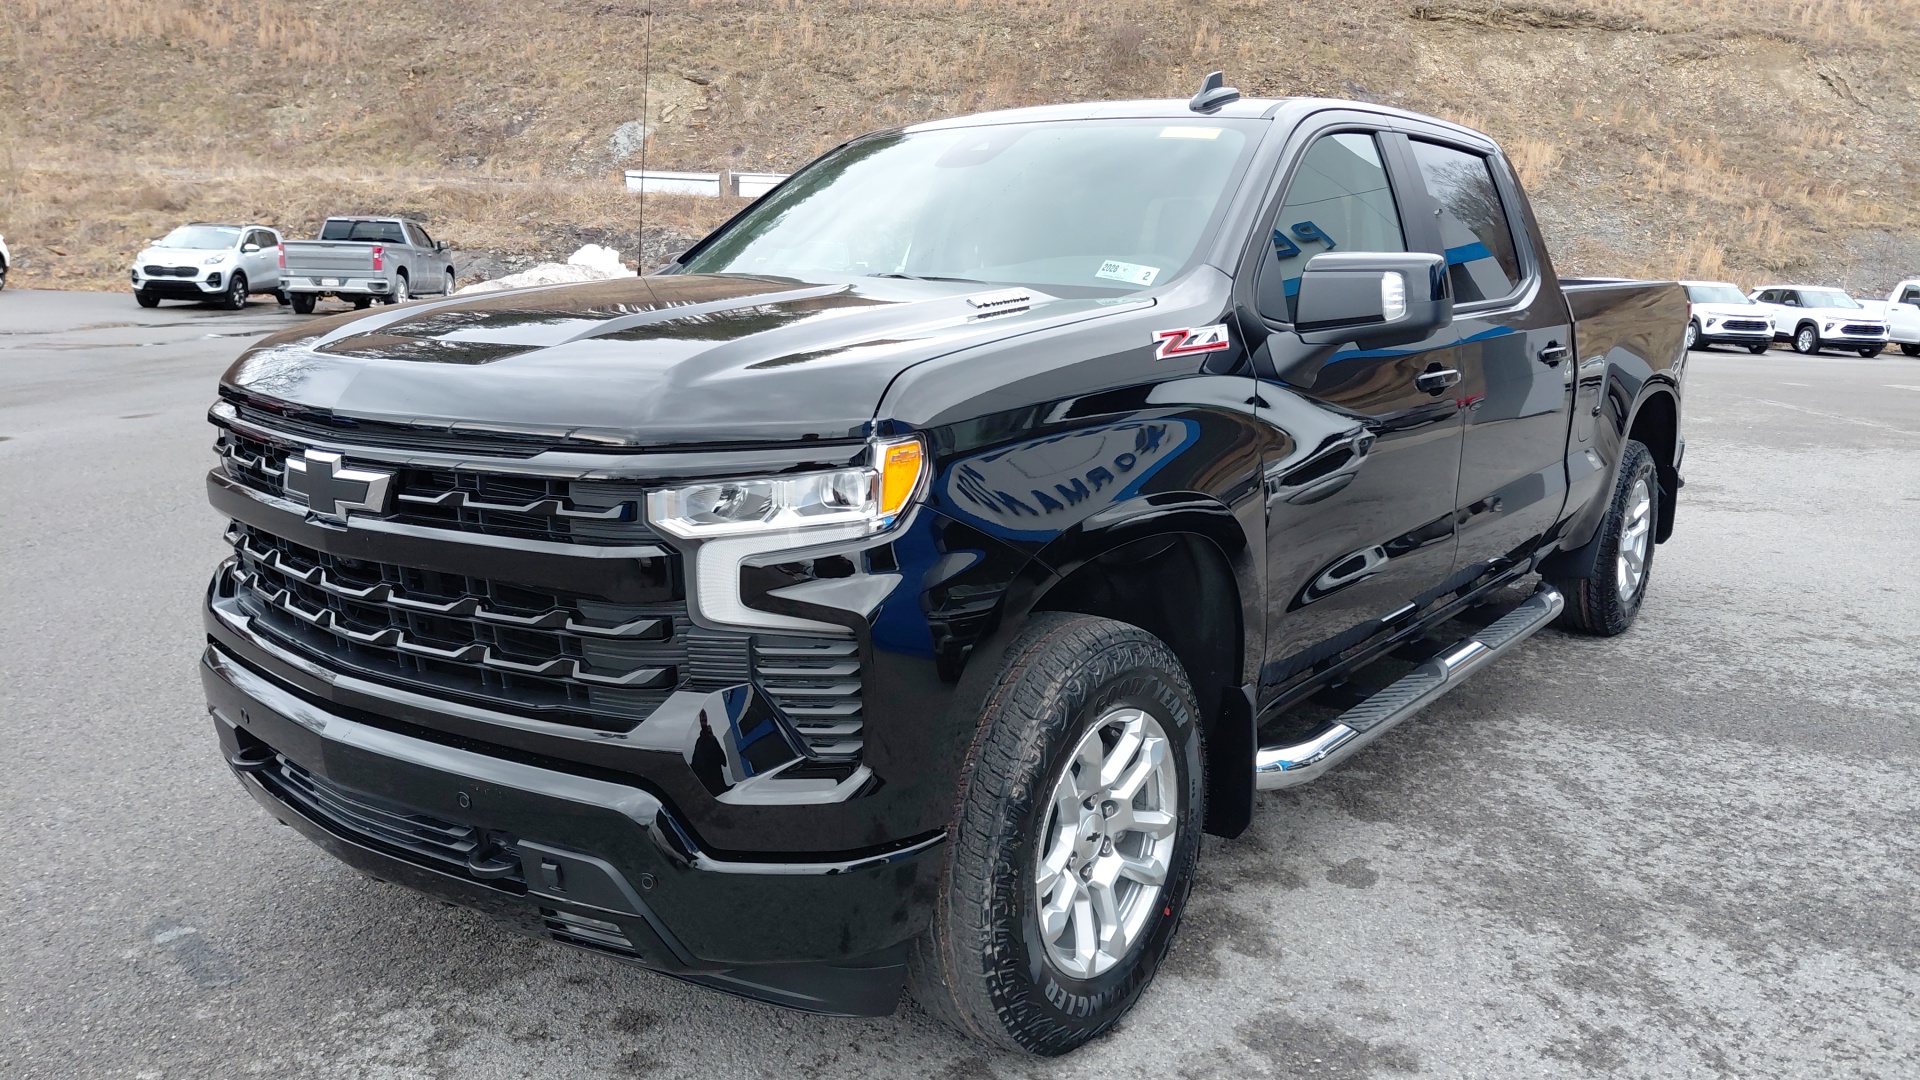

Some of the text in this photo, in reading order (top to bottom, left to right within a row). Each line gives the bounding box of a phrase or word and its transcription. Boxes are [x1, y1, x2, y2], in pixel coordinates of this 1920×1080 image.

[1142, 271, 1151, 281] 2
[1151, 323, 1230, 361] Z71
[1094, 674, 1189, 729] GOODYEAR
